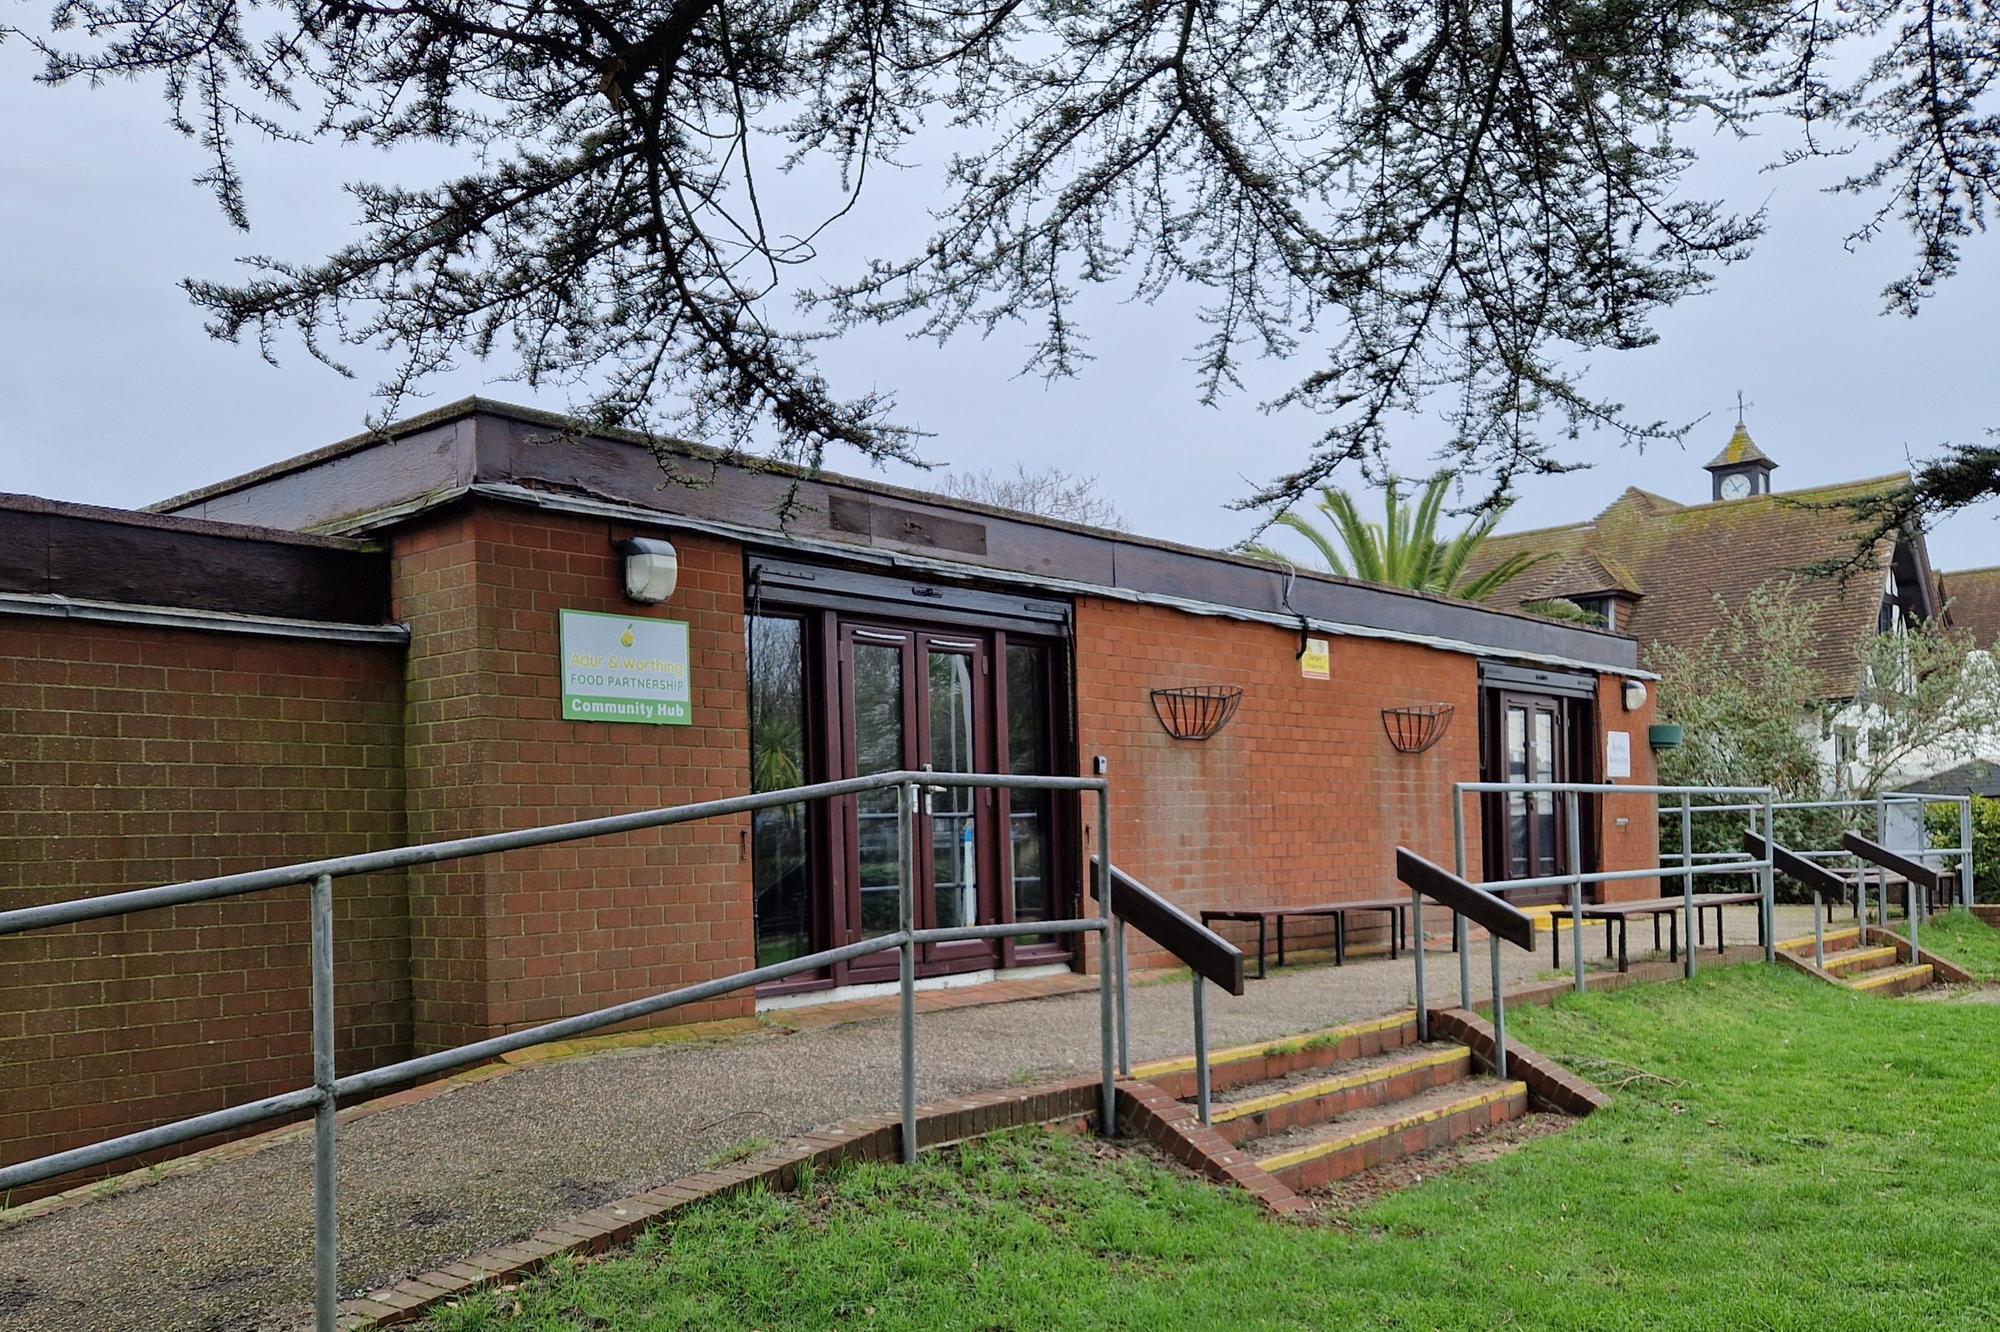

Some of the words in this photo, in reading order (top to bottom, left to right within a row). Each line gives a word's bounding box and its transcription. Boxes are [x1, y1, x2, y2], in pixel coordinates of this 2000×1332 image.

[571, 652, 604, 667] Adur
[608, 656, 618, 670] &
[623, 657, 684, 678] Worthing
[571, 674, 604, 686] FOOD
[608, 677, 684, 691] PARTNERSHIP
[572, 699, 654, 717] Community
[658, 704, 684, 717] Hub
